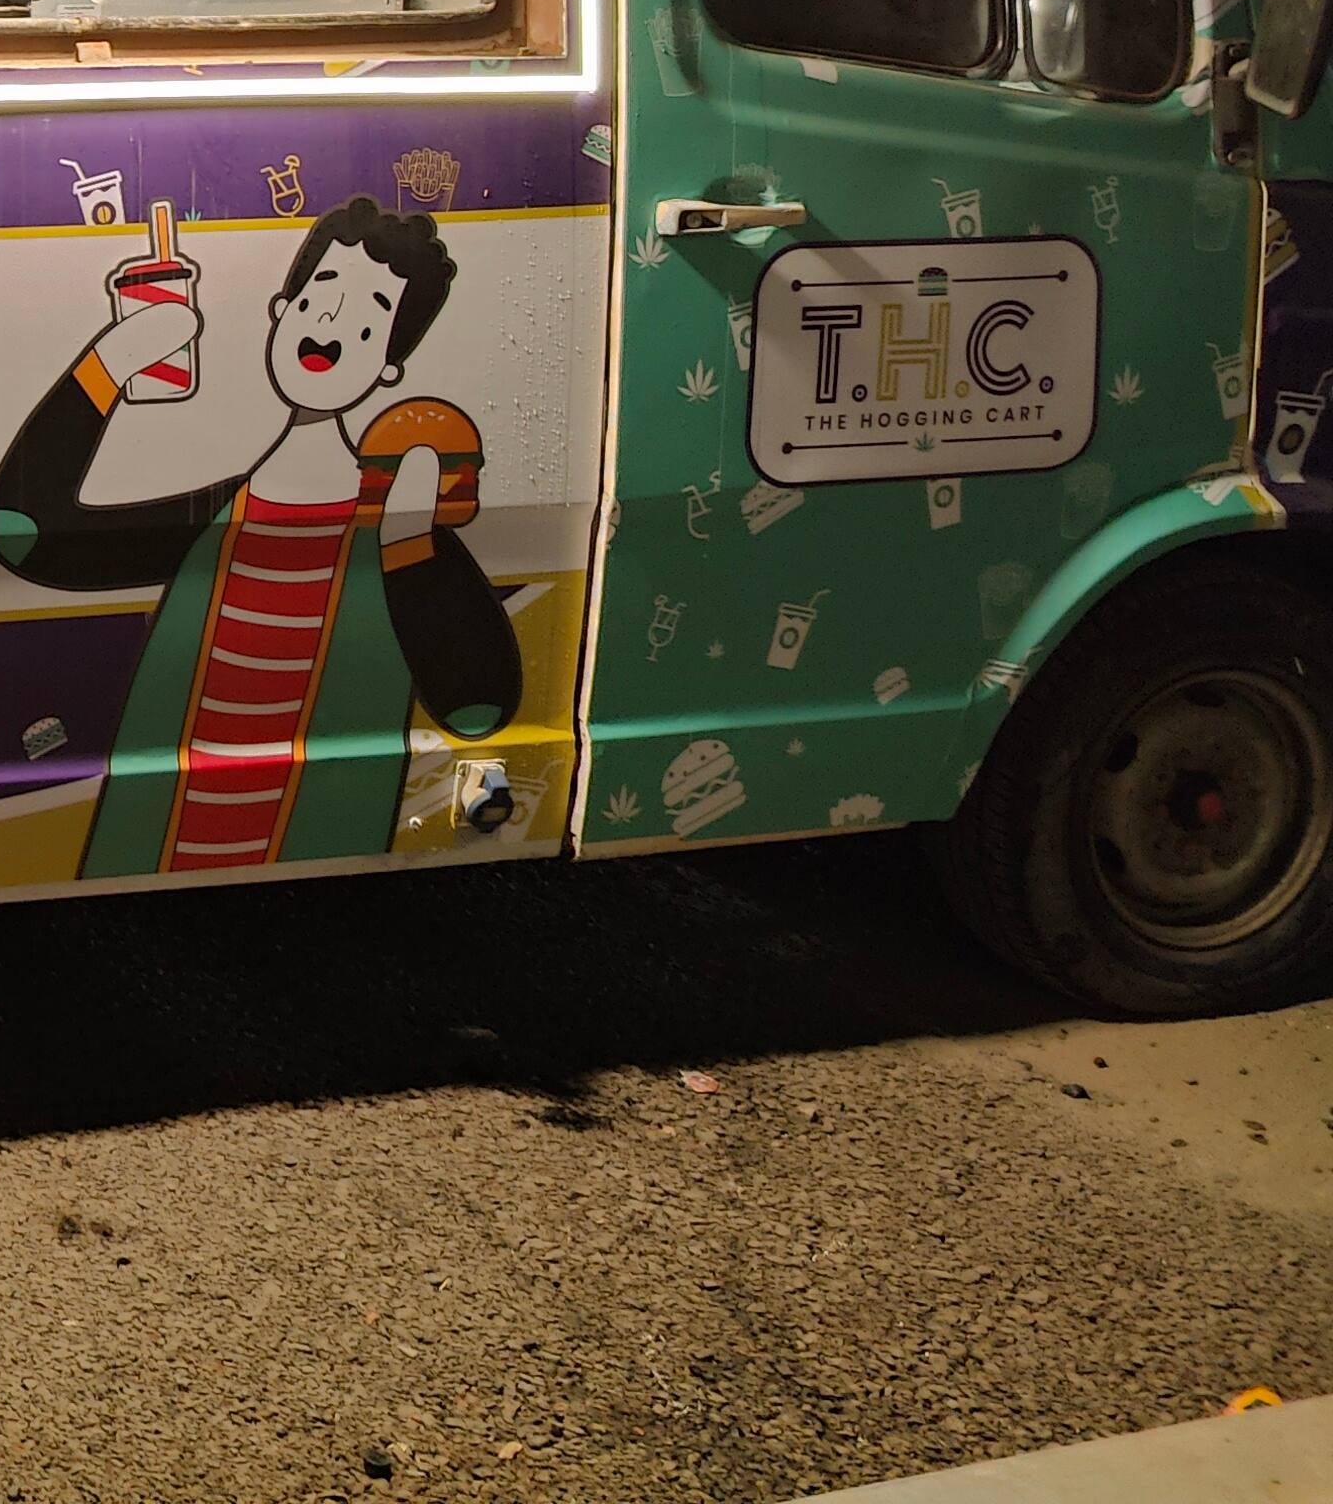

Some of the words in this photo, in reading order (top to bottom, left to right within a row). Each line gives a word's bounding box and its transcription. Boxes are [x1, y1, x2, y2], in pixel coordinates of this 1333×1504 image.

[801, 300, 1054, 404] T.H.C.
[804, 413, 848, 431] THE
[860, 408, 973, 427] HOGGING
[986, 404, 1047, 424] CART
